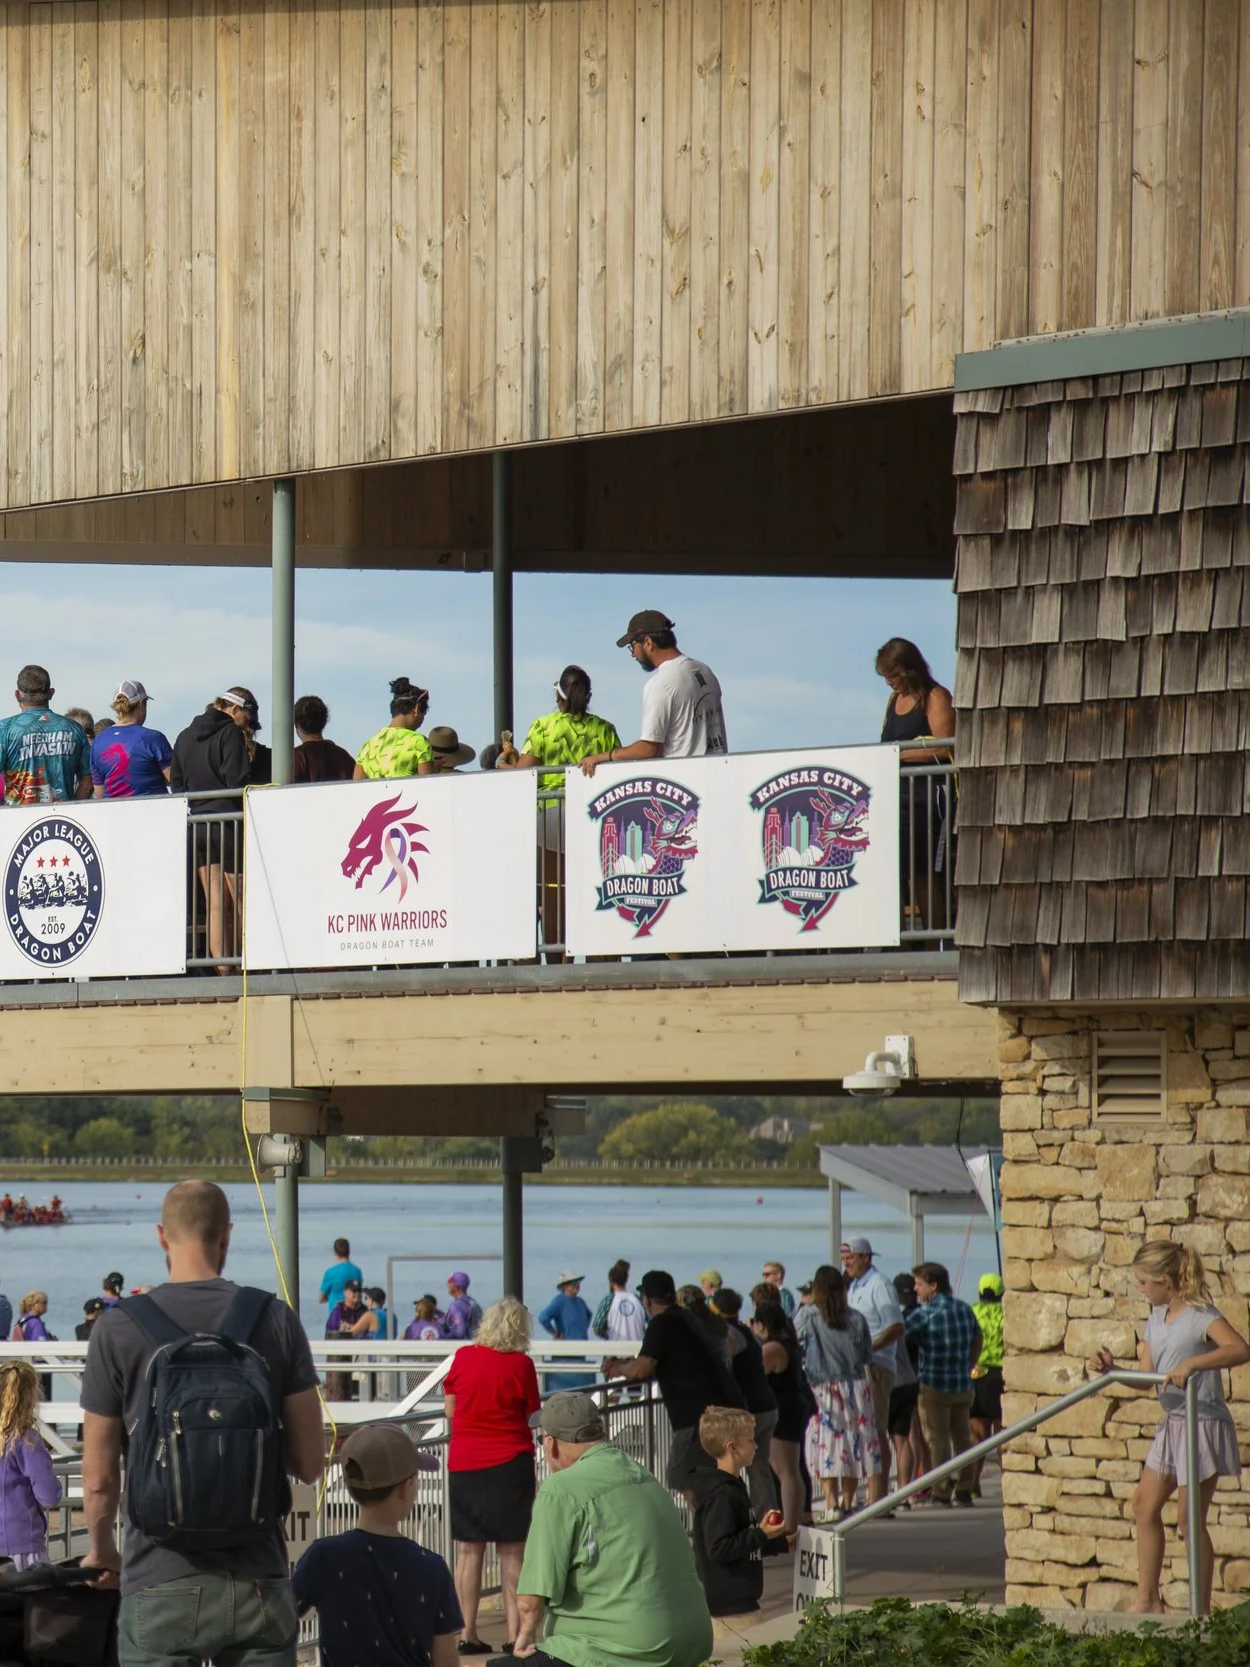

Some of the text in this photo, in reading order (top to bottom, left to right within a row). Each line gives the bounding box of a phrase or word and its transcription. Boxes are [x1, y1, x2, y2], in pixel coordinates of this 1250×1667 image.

[22, 731, 73, 746] NEEDHAM
[19, 742, 76, 761] INVASION
[594, 780, 693, 812] KANSAS CITY
[756, 770, 863, 802] KANSAS CITY
[13, 824, 95, 868] MAJOR LEAGUE
[606, 877, 680, 897] DRAGON BOAT
[769, 869, 849, 889] DRAGON BOAT
[626, 897, 656, 905] FESTIVAL
[790, 890, 824, 899] FESTIVAL
[41, 923, 66, 935] 2009
[327, 909, 447, 934] KC PINK WARRIORS
[10, 910, 96, 961] DRAGON BOAT
[340, 939, 434, 951] DRAGON BOAT TEAM
[800, 1549, 828, 1582] EXIT
